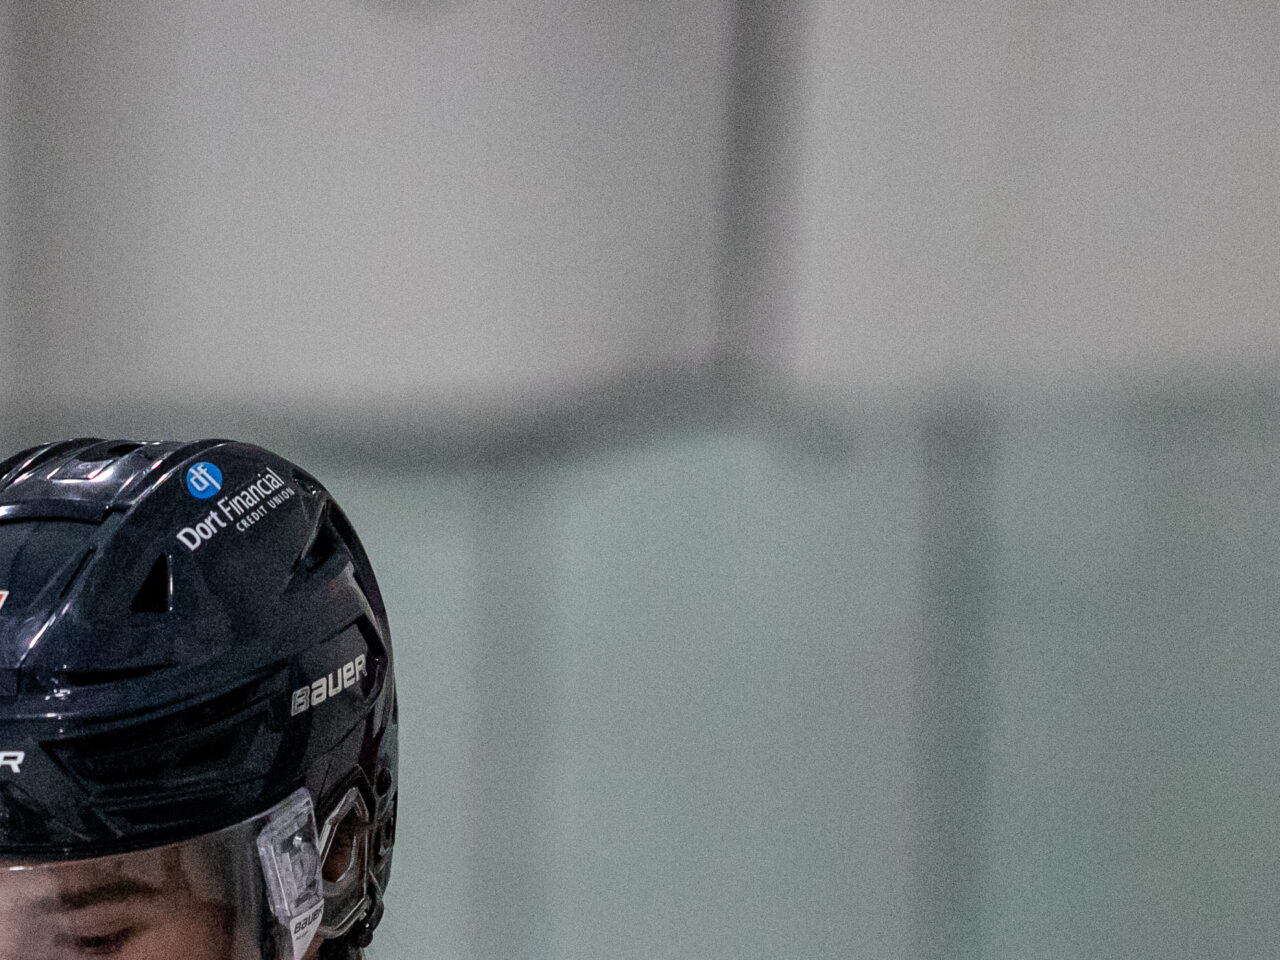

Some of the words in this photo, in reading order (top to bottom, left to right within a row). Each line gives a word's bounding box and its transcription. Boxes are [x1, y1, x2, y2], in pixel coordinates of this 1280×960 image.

[176, 510, 227, 551] Dort
[217, 466, 285, 521] Financial
[236, 505, 268, 532] CREDIT
[267, 487, 295, 509] UNION
[290, 653, 368, 717] BAUER
